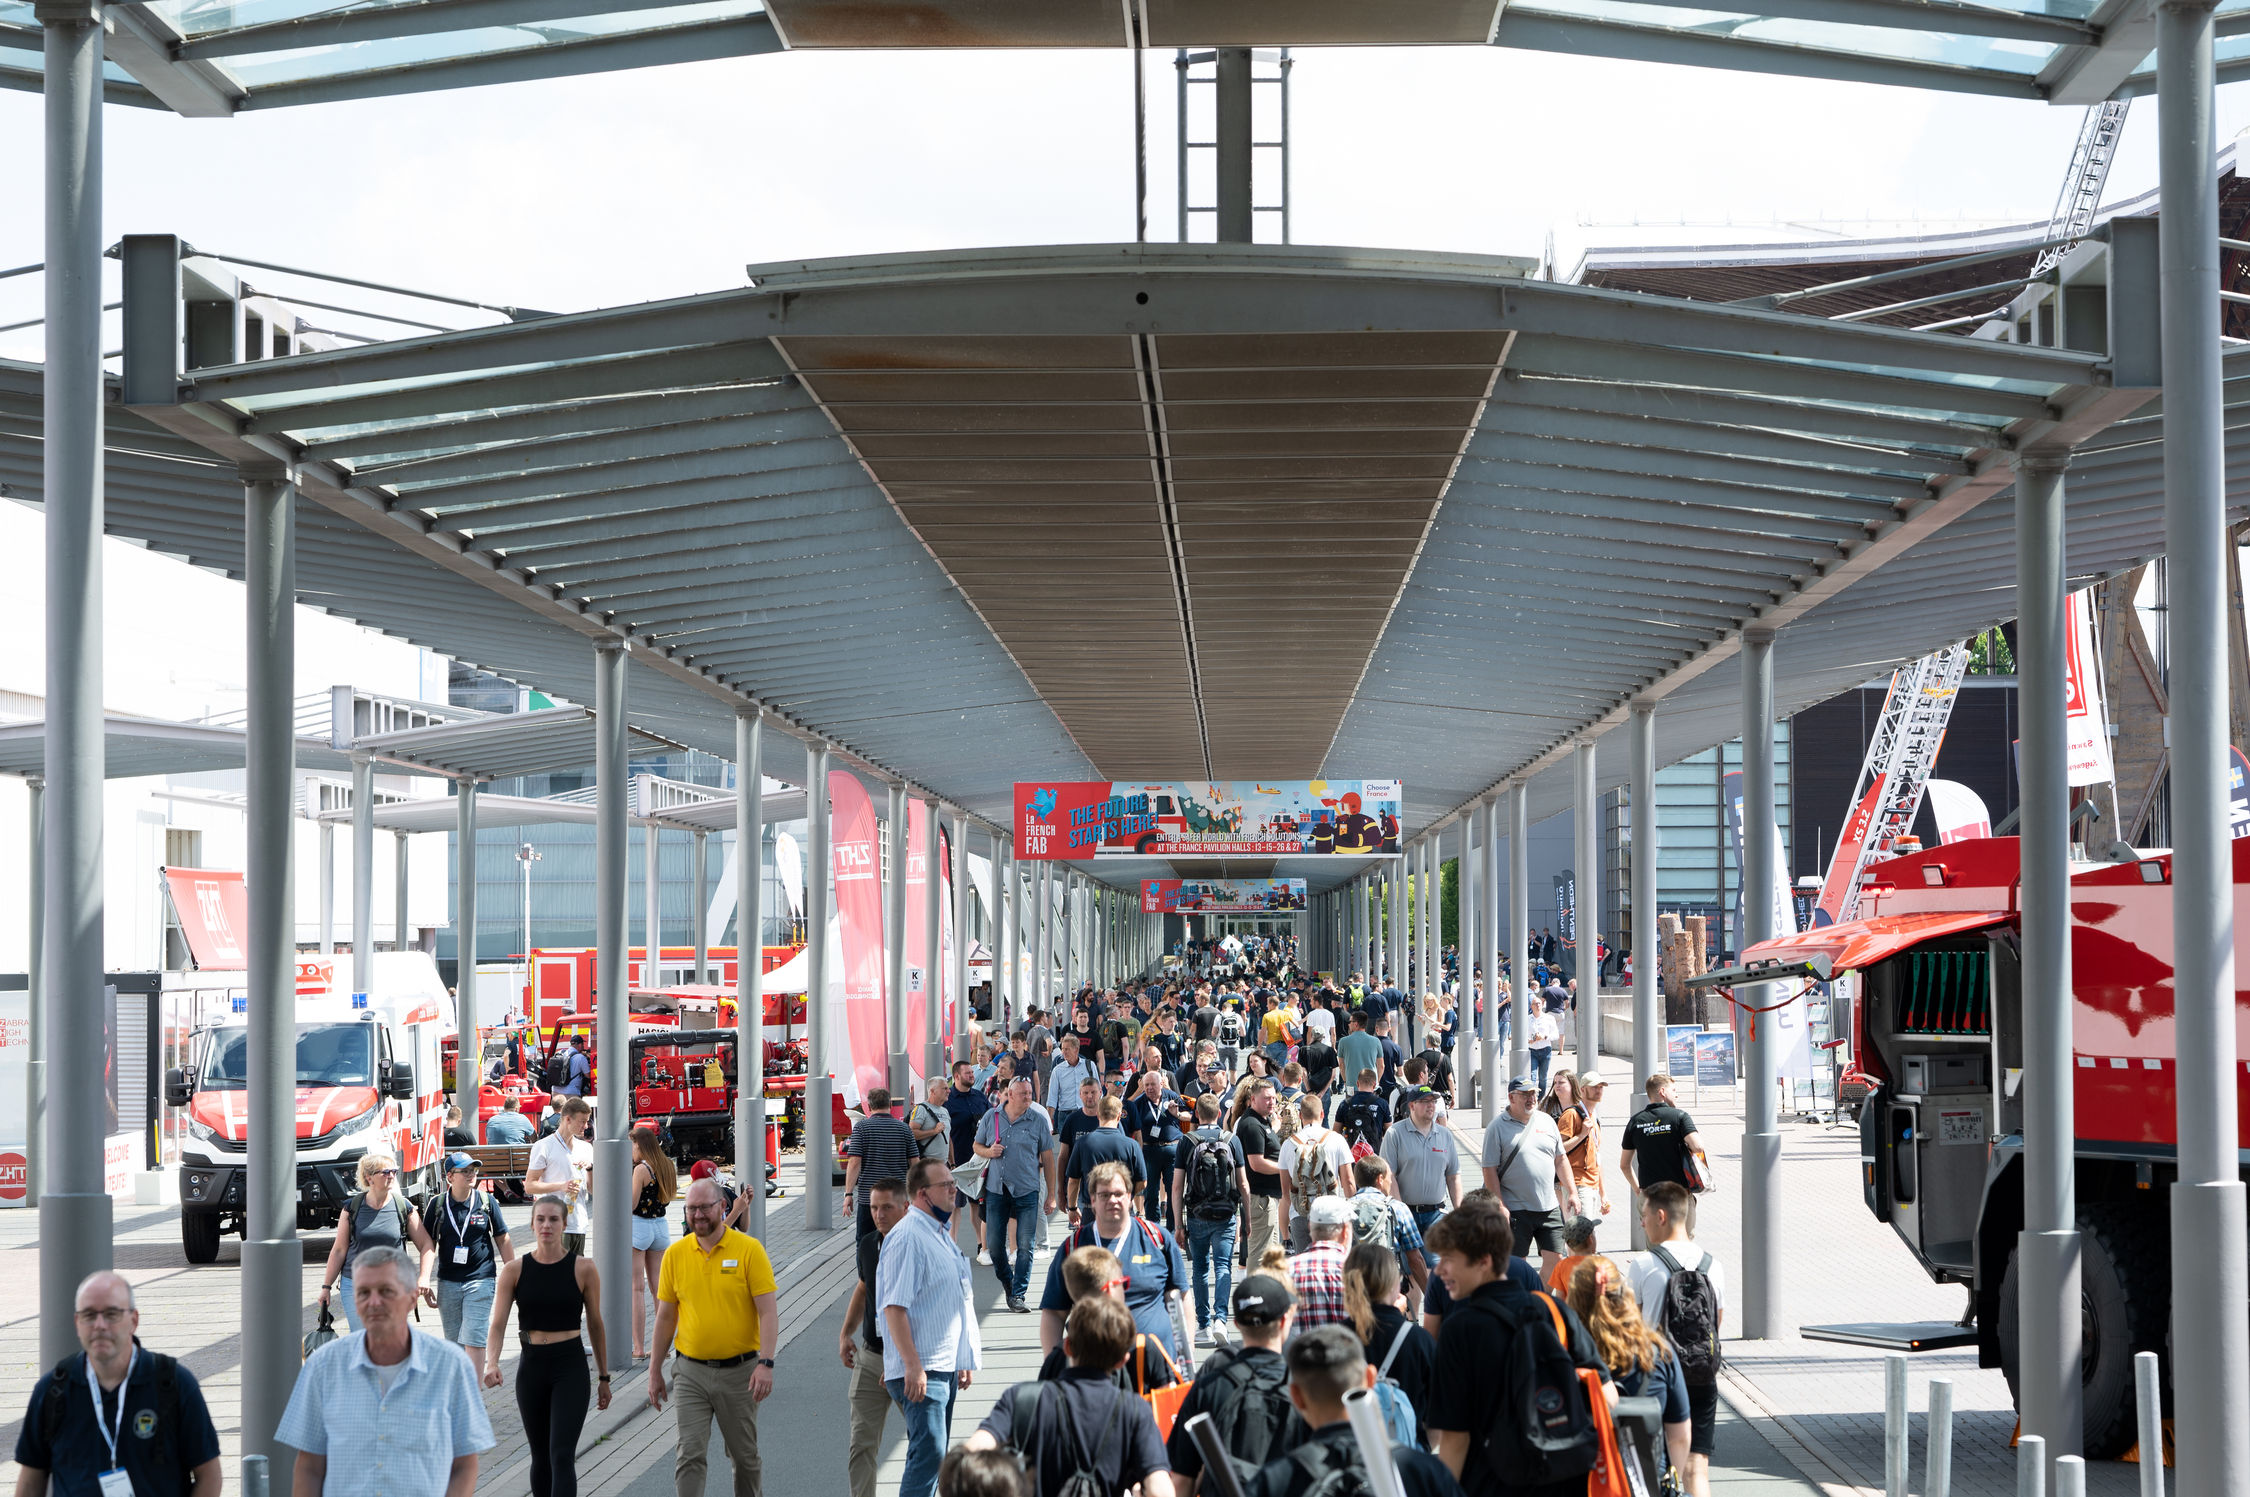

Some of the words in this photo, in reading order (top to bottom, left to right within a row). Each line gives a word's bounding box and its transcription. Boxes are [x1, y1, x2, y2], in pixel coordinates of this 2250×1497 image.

[1366, 783, 1391, 791] Choose
[1069, 804, 1095, 826] THE
[1097, 792, 1149, 821] FUTURE
[1025, 813, 1035, 825] La
[1025, 825, 1056, 836] FRENCH
[1069, 820, 1118, 848] STARTS
[1121, 811, 1159, 837] HERE!
[1156, 832, 1177, 842] ENTER
[1201, 832, 1224, 842] WORLD
[1225, 832, 1241, 842] WITH
[1241, 832, 1266, 842] FRENCH
[1266, 832, 1301, 842] SOLUTIONS
[1853, 828, 1864, 844] XS
[1025, 837, 1048, 854] FAB
[1157, 842, 1166, 852] AT
[1166, 842, 1178, 852] THE
[1178, 842, 1202, 852] FRANCE
[1203, 842, 1231, 852] PAVILION
[1231, 842, 1251, 852] HALLS
[1292, 842, 1300, 851] 27
[1145, 903, 1156, 911] FAB
[911, 971, 919, 980] K
[1839, 979, 1846, 987] K
[1643, 1124, 1672, 1134] FORCE
[104, 1144, 130, 1165] ELCOME
[0, 1166, 26, 1180] ZHT
